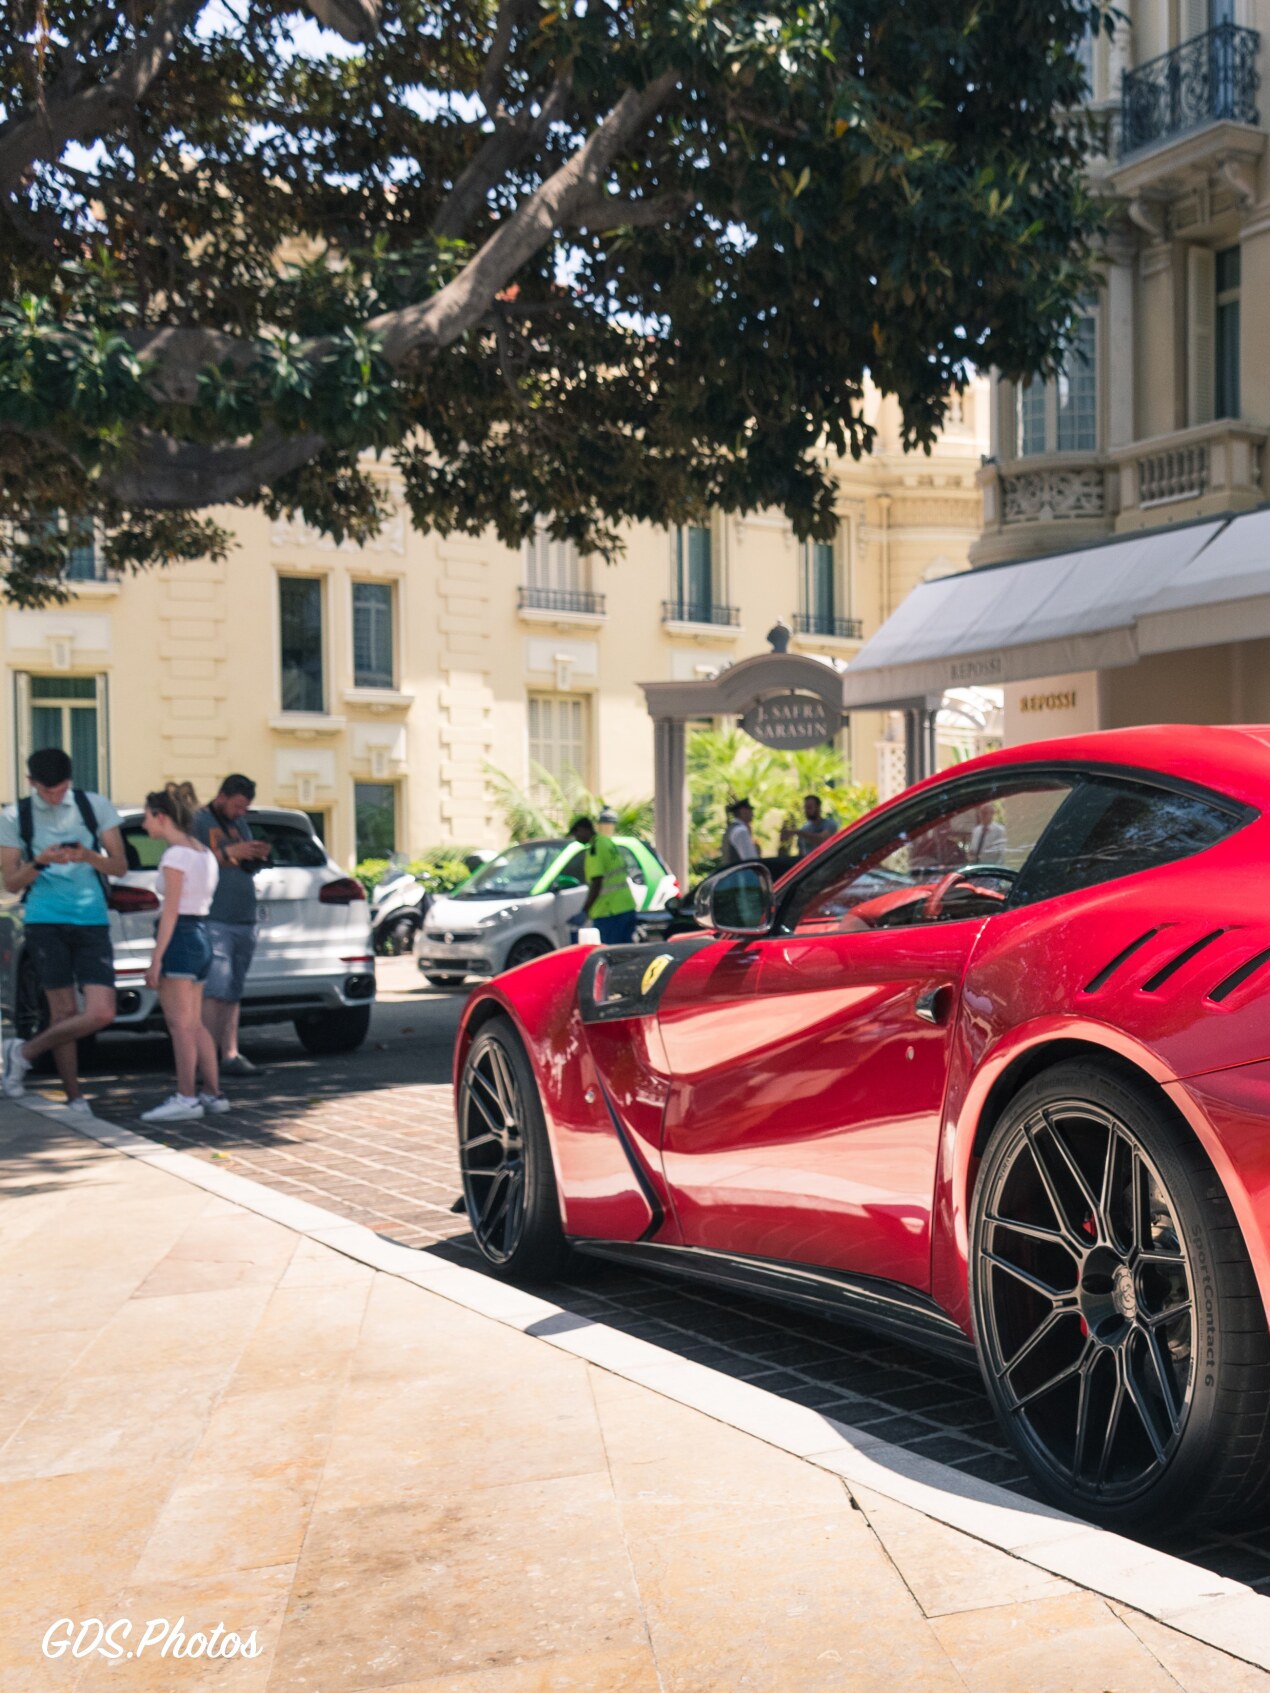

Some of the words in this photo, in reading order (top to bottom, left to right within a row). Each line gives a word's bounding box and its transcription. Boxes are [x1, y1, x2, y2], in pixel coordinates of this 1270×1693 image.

[951, 658, 1001, 680] REPOSSI
[1020, 690, 1077, 714] REPOSSI
[754, 721, 828, 739] SARASIN
[1191, 1223, 1216, 1369] SportContact
[1204, 1376, 1216, 1388] 6
